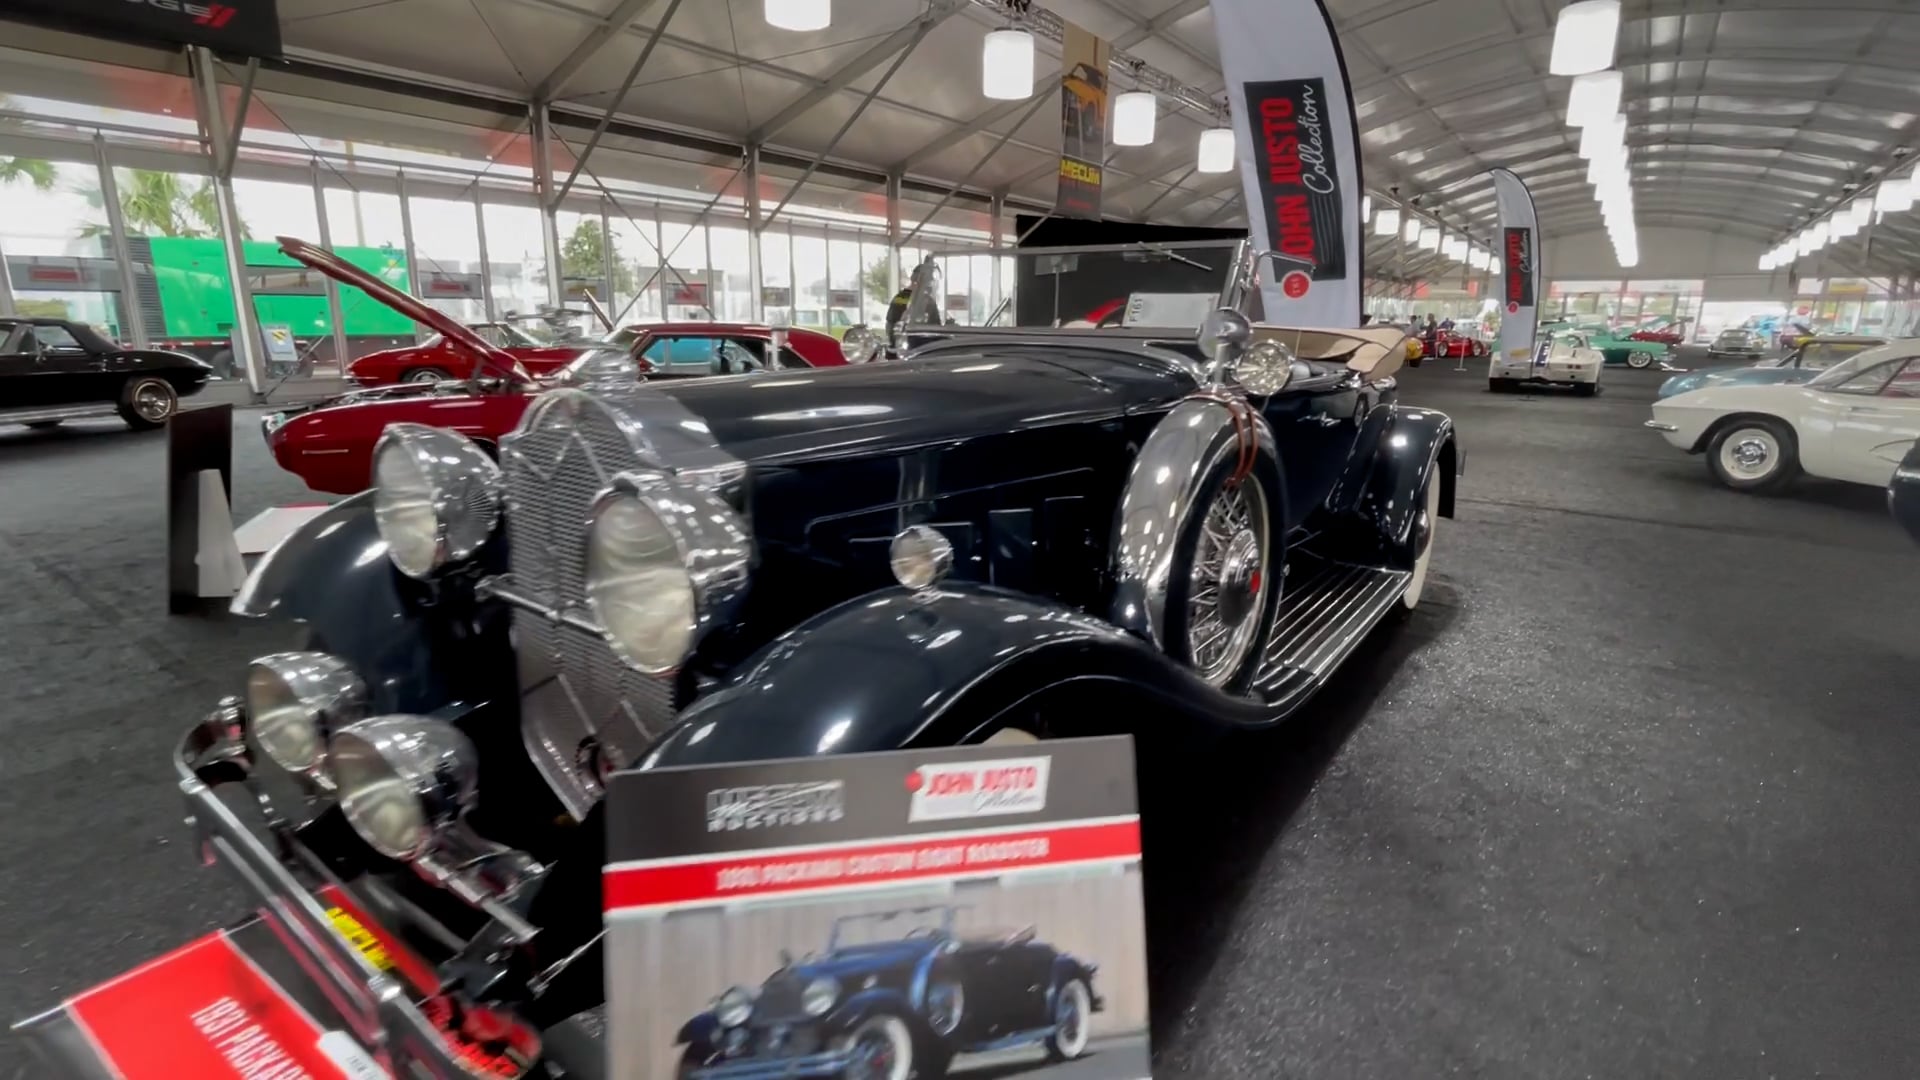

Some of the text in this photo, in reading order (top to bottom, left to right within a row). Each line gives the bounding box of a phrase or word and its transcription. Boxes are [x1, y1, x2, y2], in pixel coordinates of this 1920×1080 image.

[1260, 98, 1303, 185] JUSTO
[1297, 84, 1335, 194] Collection
[190, 996, 251, 1041] 1931
